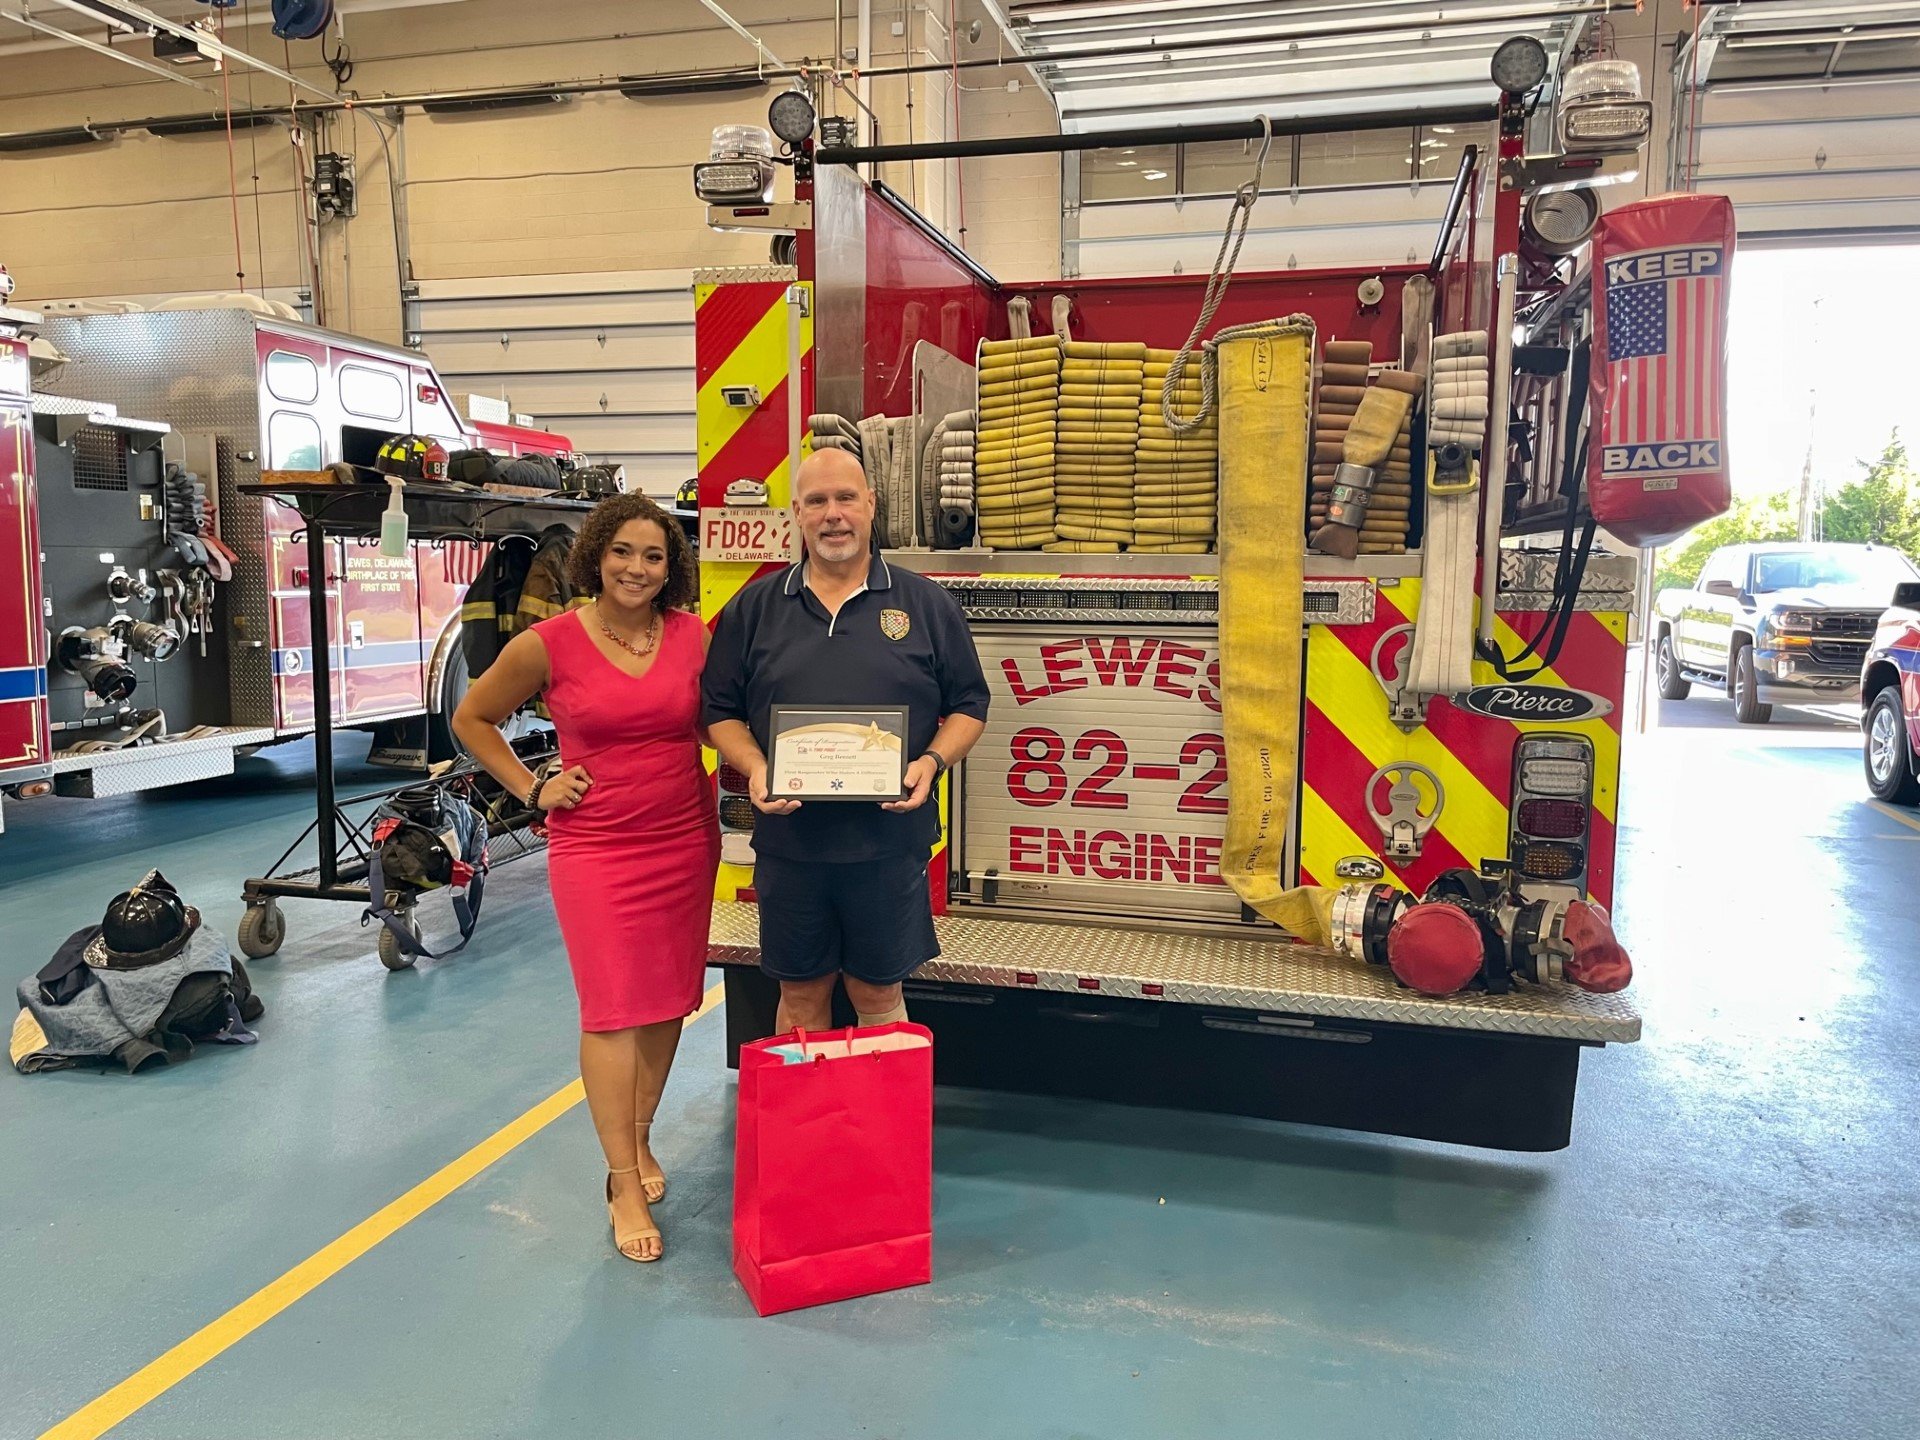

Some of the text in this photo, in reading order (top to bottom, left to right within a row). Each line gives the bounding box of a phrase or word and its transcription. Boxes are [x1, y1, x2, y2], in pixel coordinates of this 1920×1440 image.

[1609, 250, 1719, 284] KEEP
[1604, 443, 1718, 472] BACK
[706, 520, 766, 549] FD82
[725, 552, 774, 560] DELAWARE
[360, 582, 401, 592] FIRST STATE
[389, 570, 400, 580] OF
[1484, 687, 1575, 713] Pierce
[1007, 727, 1229, 815] 82-2
[1259, 747, 1273, 779] 2020
[1263, 785, 1273, 803] CO
[1258, 808, 1271, 840] FIRE
[1009, 826, 1227, 885] ENGINE
